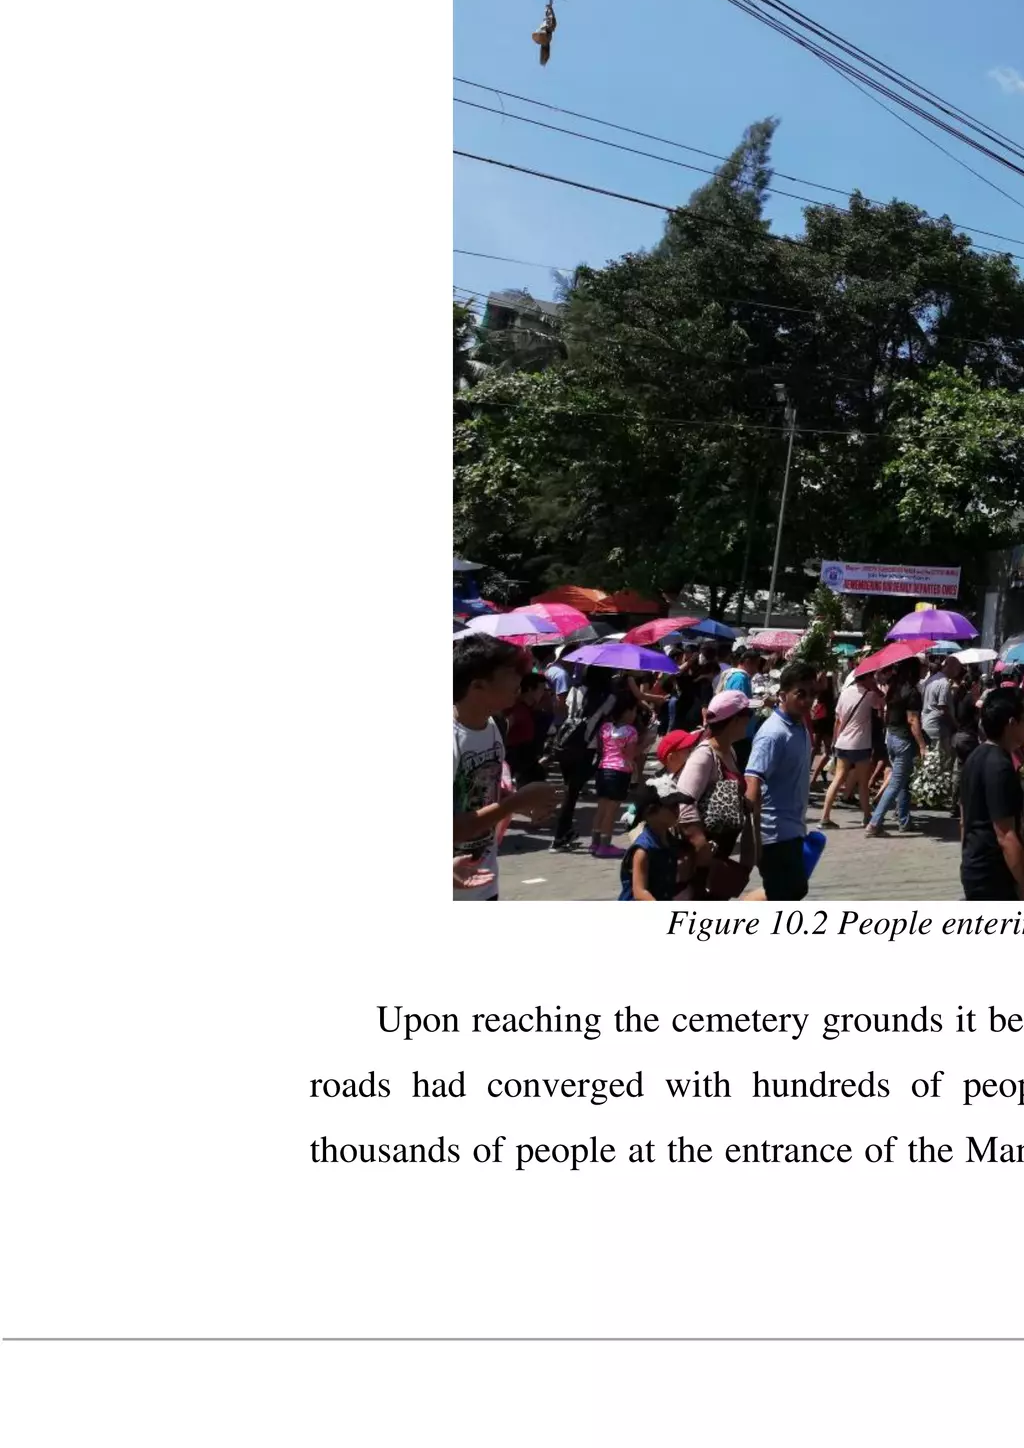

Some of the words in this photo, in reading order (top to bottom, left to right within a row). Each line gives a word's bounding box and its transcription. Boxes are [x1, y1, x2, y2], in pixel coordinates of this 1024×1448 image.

[666, 910, 760, 942] Figure
[770, 910, 828, 935] 10.2
[837, 910, 933, 942] People
[376, 1005, 460, 1041] Upon
[471, 1005, 602, 1041] reaching
[614, 1005, 660, 1033] the
[672, 1009, 810, 1041] cemetery
[822, 1005, 943, 1041] grounds
[955, 1005, 977, 1033] it
[309, 1070, 391, 1098] roads
[412, 1070, 466, 1098] had
[487, 1070, 645, 1106] converged
[665, 1070, 732, 1098] with
[752, 1070, 890, 1098] hundreds
[911, 1070, 945, 1098] of
[309, 1135, 461, 1163] thousands
[473, 1135, 507, 1163] of
[515, 1135, 616, 1171] people
[628, 1139, 656, 1163] at
[667, 1135, 713, 1163] the
[725, 1140, 853, 1163] entrance
[864, 1135, 899, 1163] of
[907, 1135, 954, 1163] the
